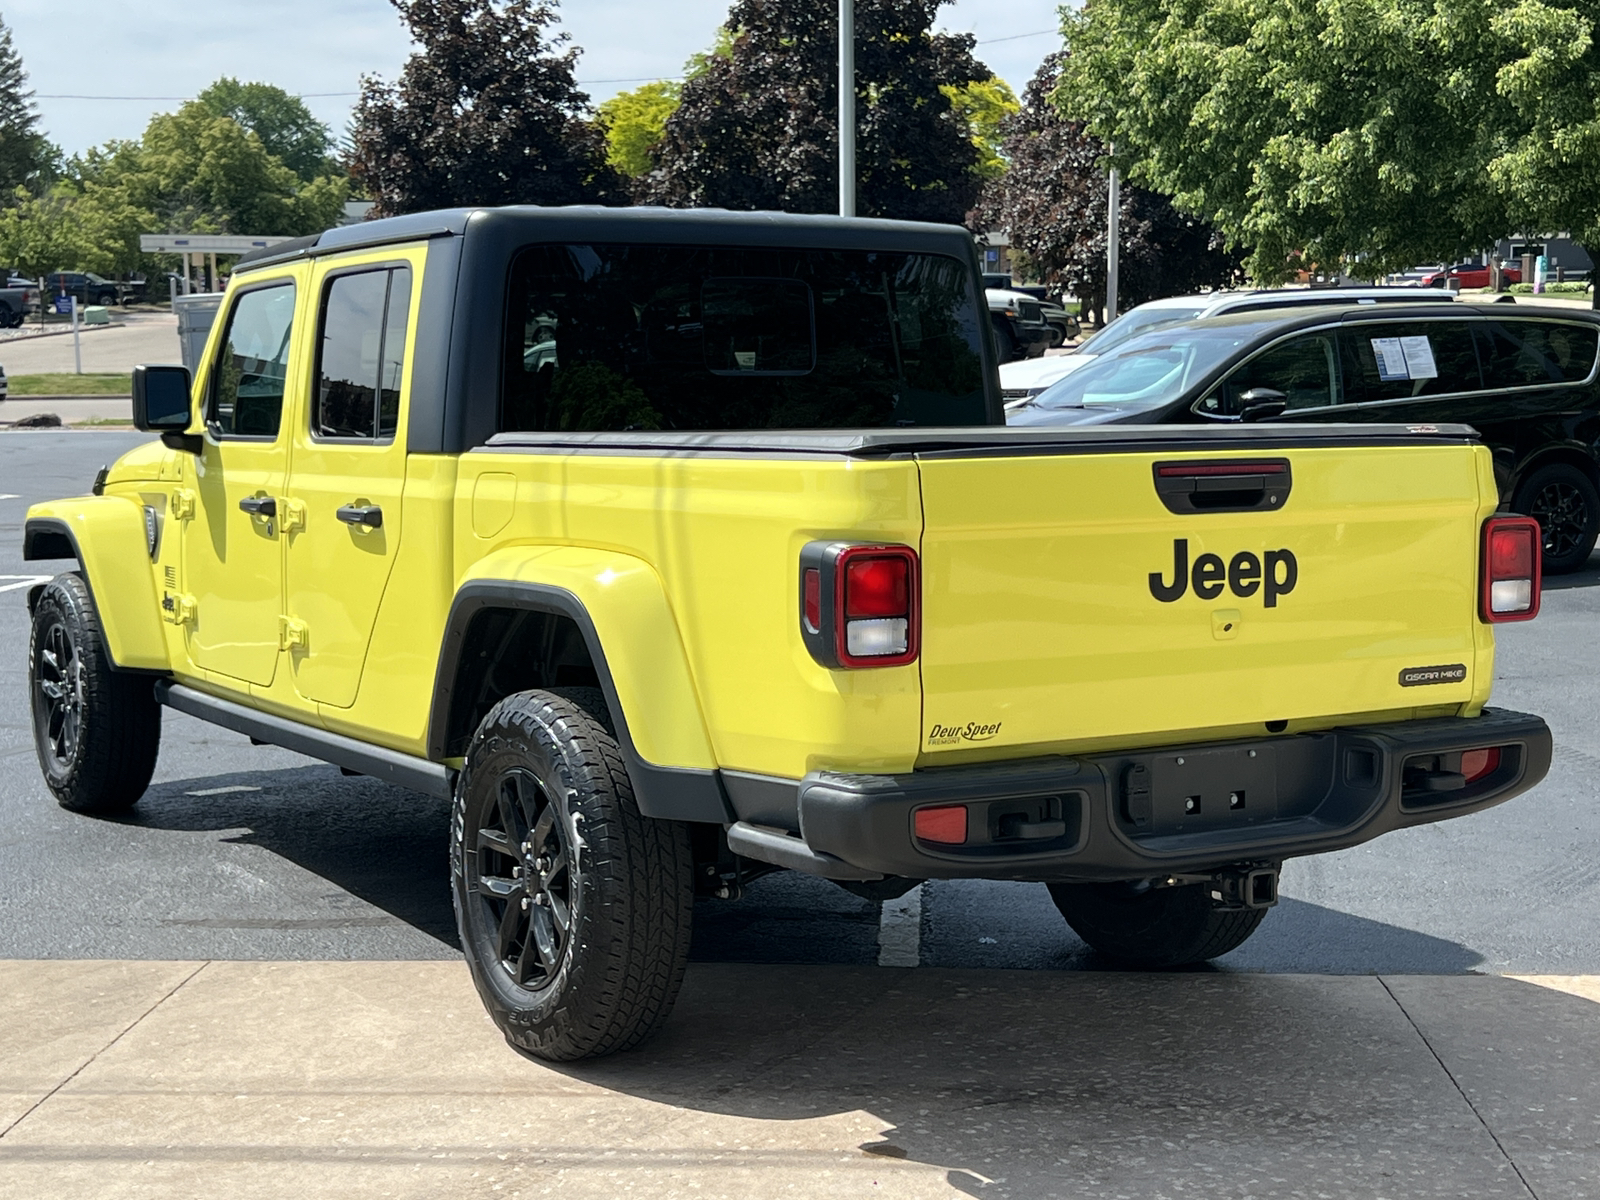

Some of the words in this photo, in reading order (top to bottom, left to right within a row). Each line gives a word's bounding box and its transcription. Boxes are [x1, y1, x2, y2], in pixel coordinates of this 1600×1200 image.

[1148, 538, 1298, 608] Jeep
[1405, 672, 1439, 681] OSCAR
[1440, 670, 1463, 678] MIKE
[929, 724, 963, 739] Deur
[963, 721, 1002, 740] Speet
